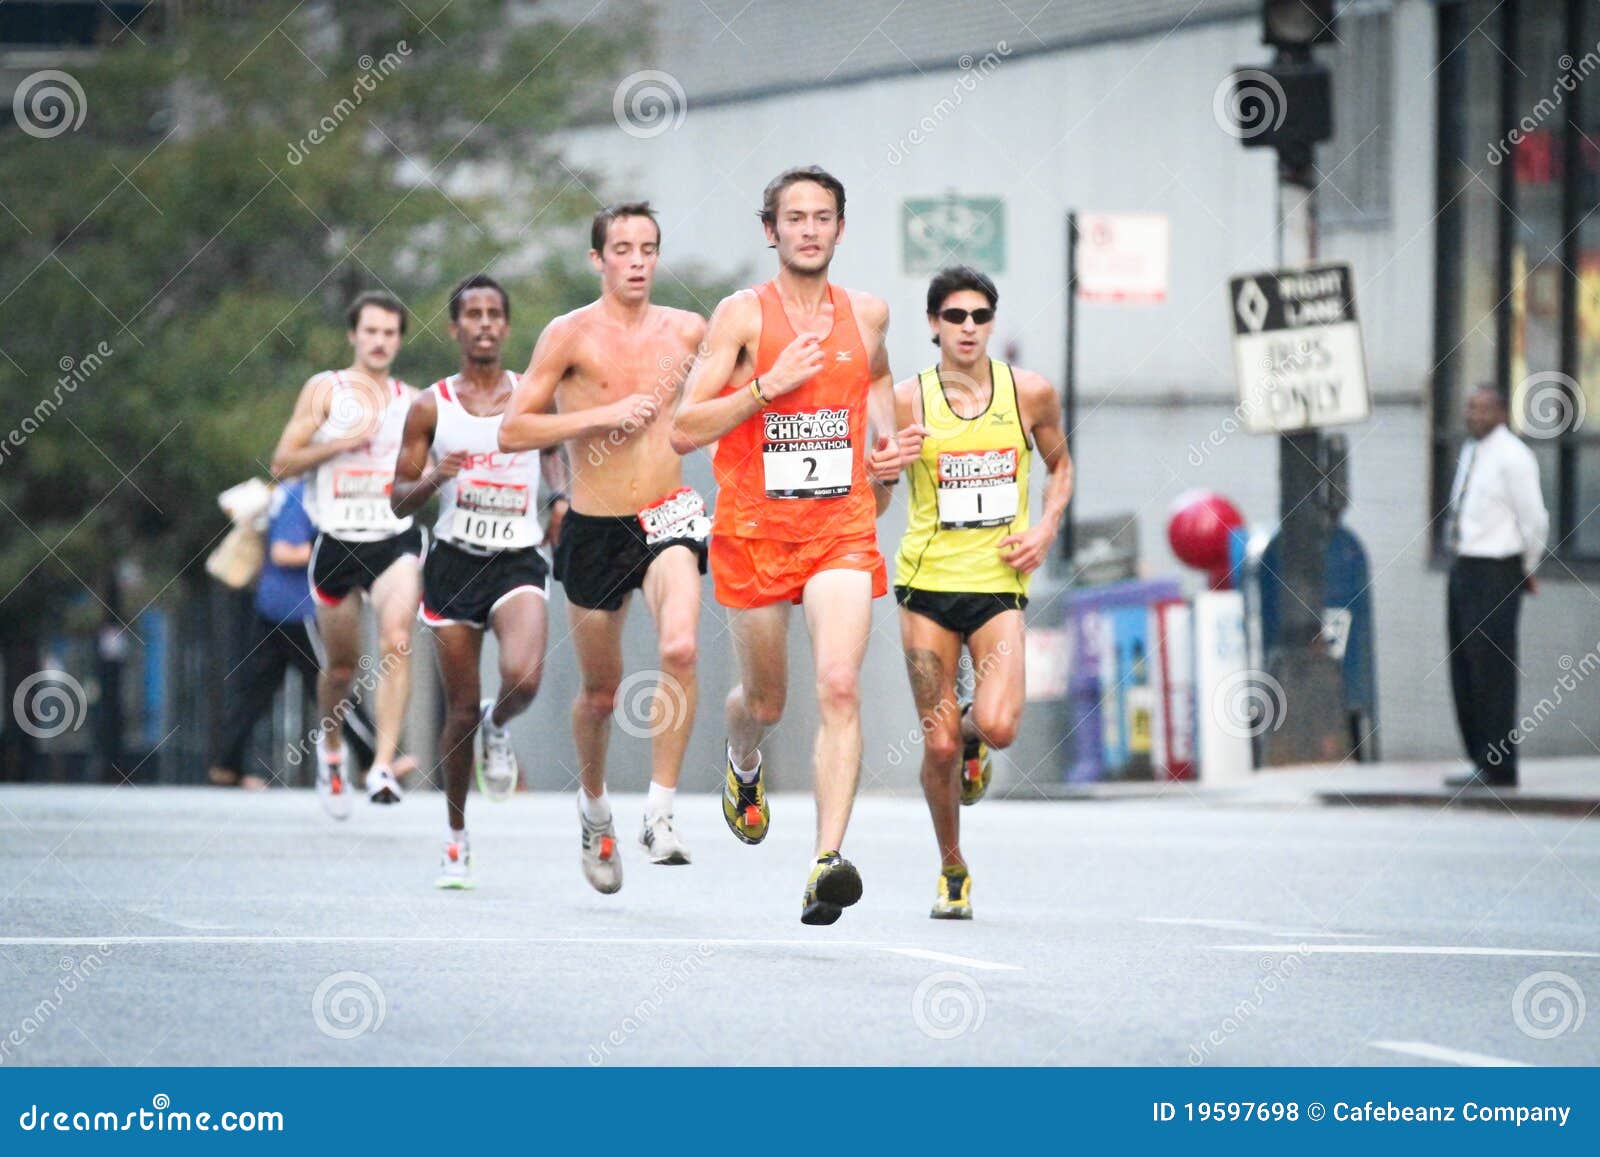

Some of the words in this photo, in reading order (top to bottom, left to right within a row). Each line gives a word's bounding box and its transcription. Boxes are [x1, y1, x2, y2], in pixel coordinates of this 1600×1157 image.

[764, 412, 804, 424] Rock
[818, 409, 849, 420] Roll
[765, 420, 848, 440] CHICAGO
[768, 443, 786, 453] 1/2
[789, 440, 848, 452] MARATHON
[802, 456, 820, 483] 2
[941, 460, 1015, 479] CHICAGO
[959, 477, 1014, 489] MARATHON
[977, 492, 983, 514] 1
[465, 516, 515, 541] 1016
